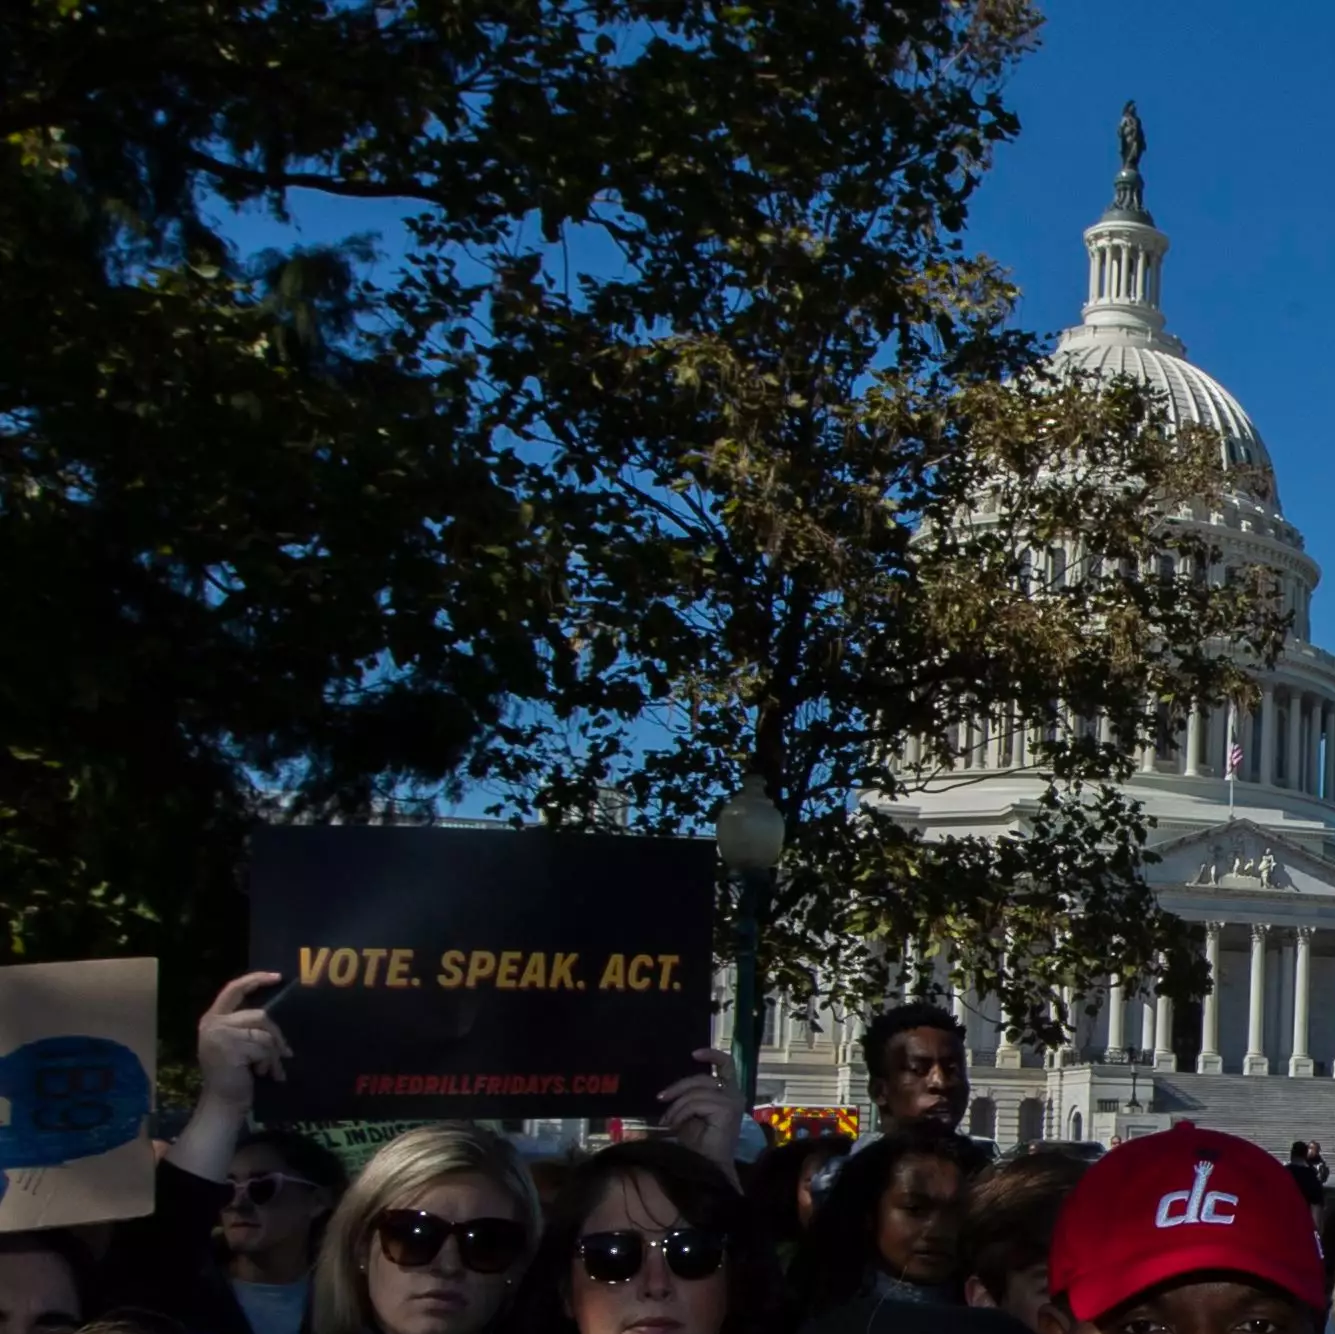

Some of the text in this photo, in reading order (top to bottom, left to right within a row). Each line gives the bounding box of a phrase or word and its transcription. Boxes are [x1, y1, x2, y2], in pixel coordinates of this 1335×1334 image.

[299, 947, 682, 992] VOTE. SPEAK. ACT.
[354, 1073, 620, 1097] FIREDRILLFRIDAYS.COM
